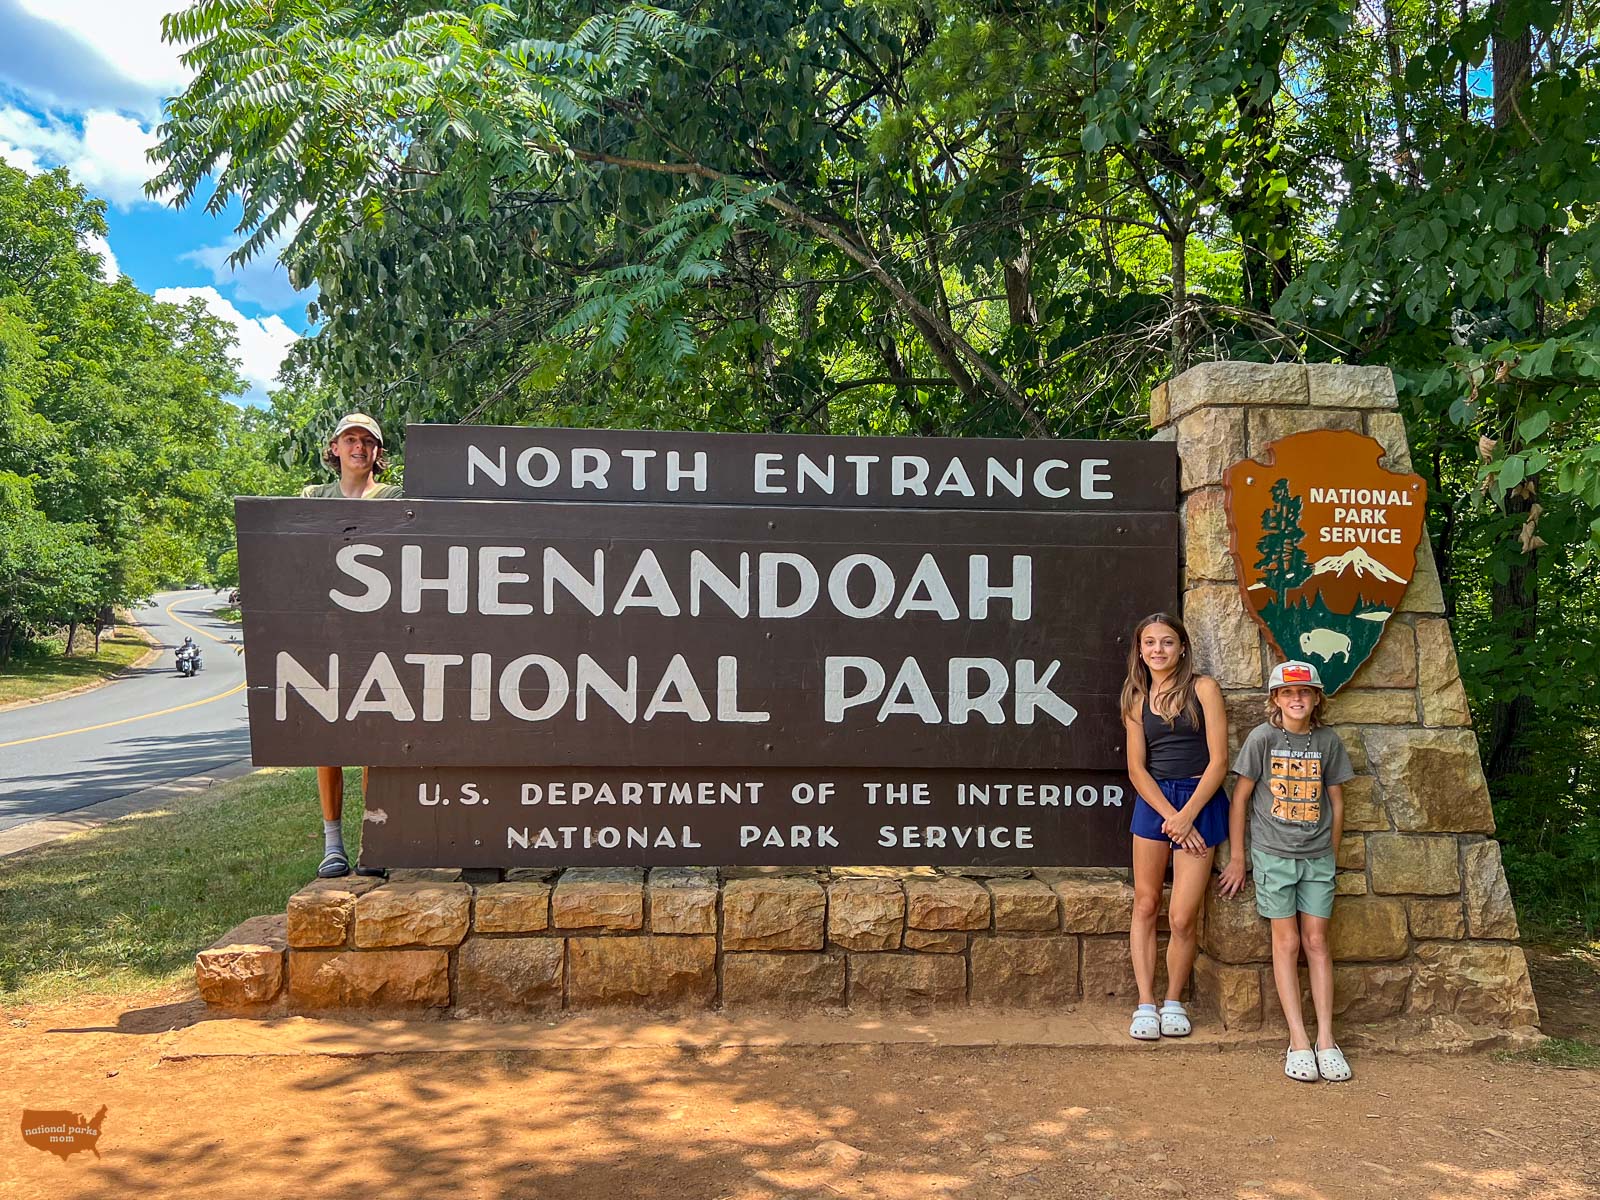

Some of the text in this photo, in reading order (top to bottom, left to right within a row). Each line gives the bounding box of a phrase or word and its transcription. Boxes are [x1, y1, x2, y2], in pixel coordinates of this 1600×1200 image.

[467, 444, 1114, 500] NORTH ENTRANCE
[1310, 487, 1413, 506] NATIONAL
[1334, 507, 1387, 525] PARK
[1319, 526, 1402, 544] SERVICE
[328, 543, 1033, 622] SHENANDOAH
[275, 651, 1078, 727] NATIONAL PARK
[418, 782, 1124, 807] U.S. DEPARTMENT OF THE INTERIOR
[507, 825, 1034, 849] NATIONAL PARK SERVICE
